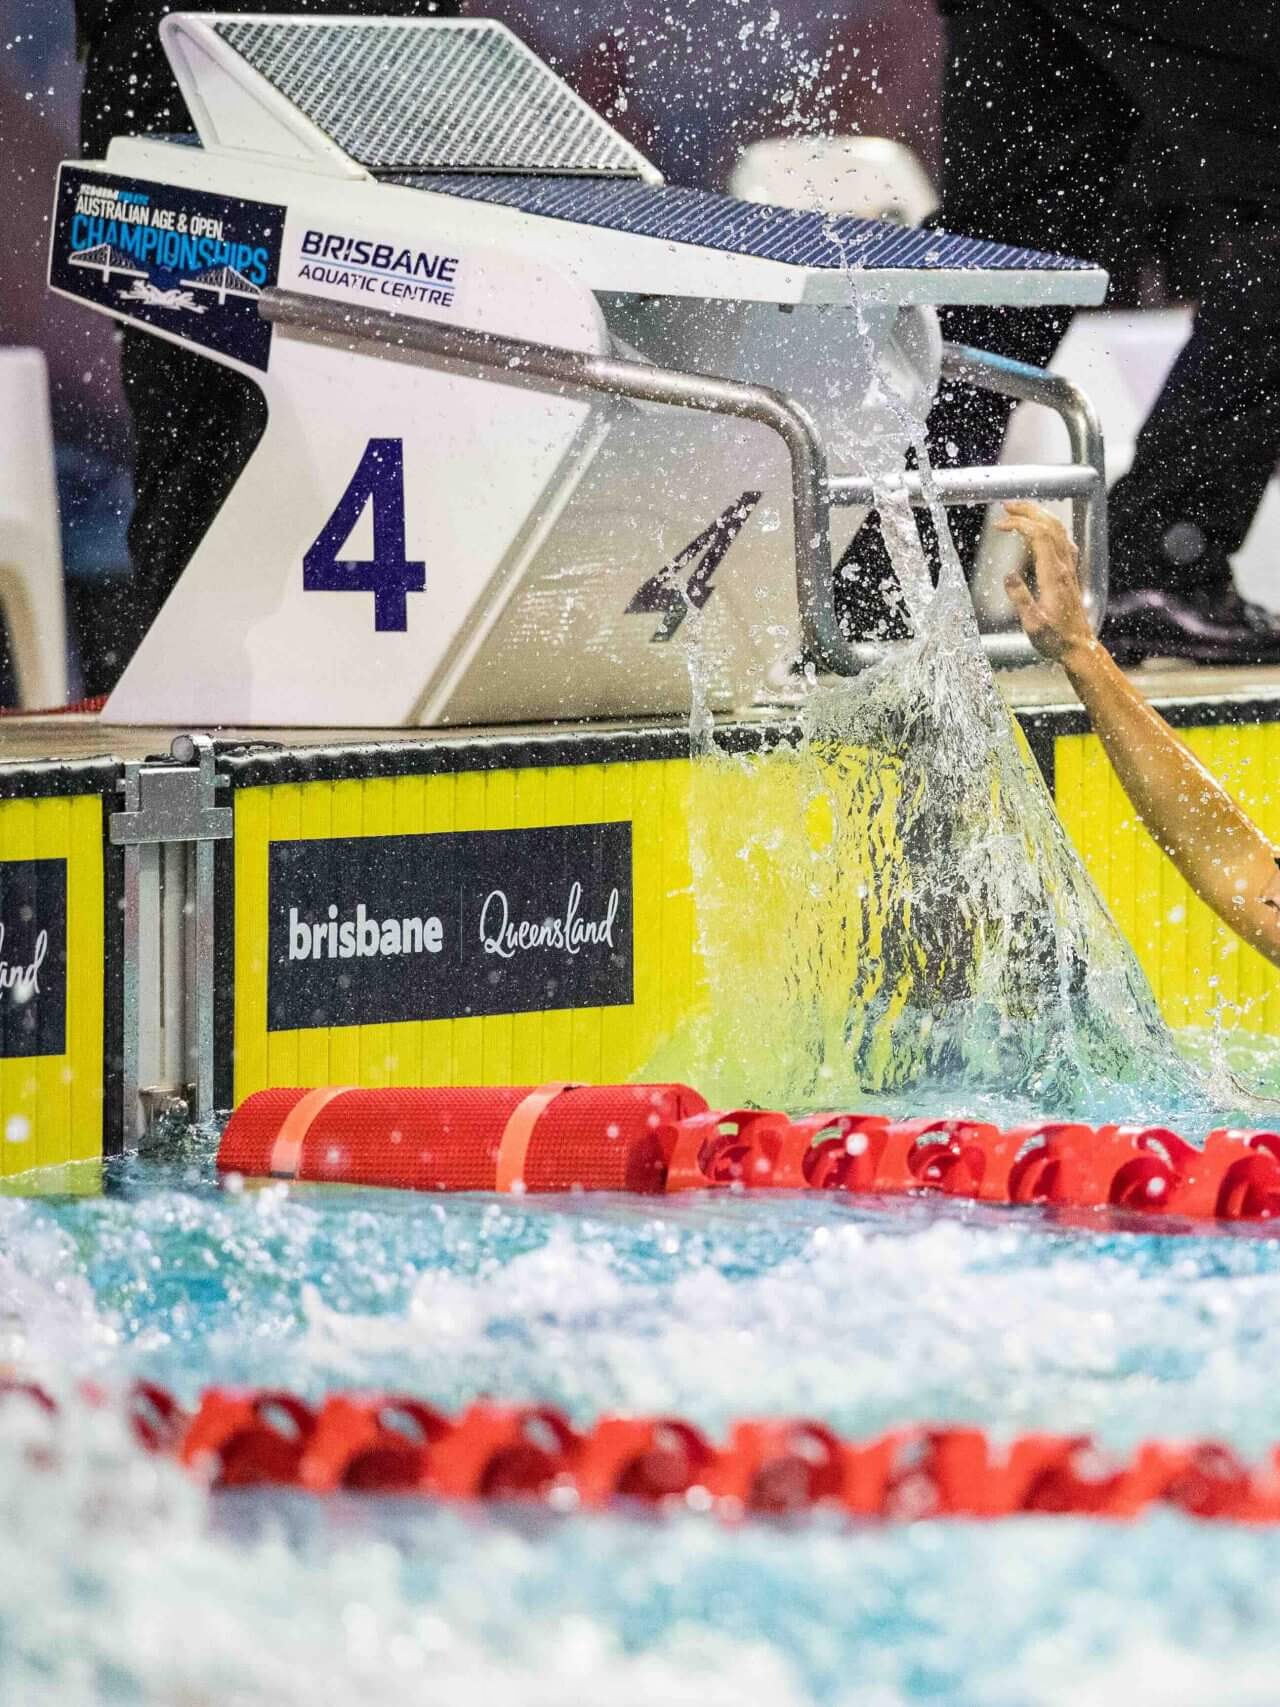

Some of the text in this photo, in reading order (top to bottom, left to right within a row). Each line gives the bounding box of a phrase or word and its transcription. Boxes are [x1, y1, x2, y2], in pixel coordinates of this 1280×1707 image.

[71, 214, 270, 285] CHAMPIONSHIPS
[75, 195, 150, 226] AUSTRALIAN
[151, 208, 176, 229] AGE
[176, 214, 188, 233] &
[190, 215, 223, 240] OPEN
[298, 264, 455, 307] AQUATIC CENTRE
[301, 230, 458, 282] BRISBANE
[303, 438, 426, 632] 4
[623, 491, 764, 642] 4
[288, 881, 619, 960] brisbane Queensland
